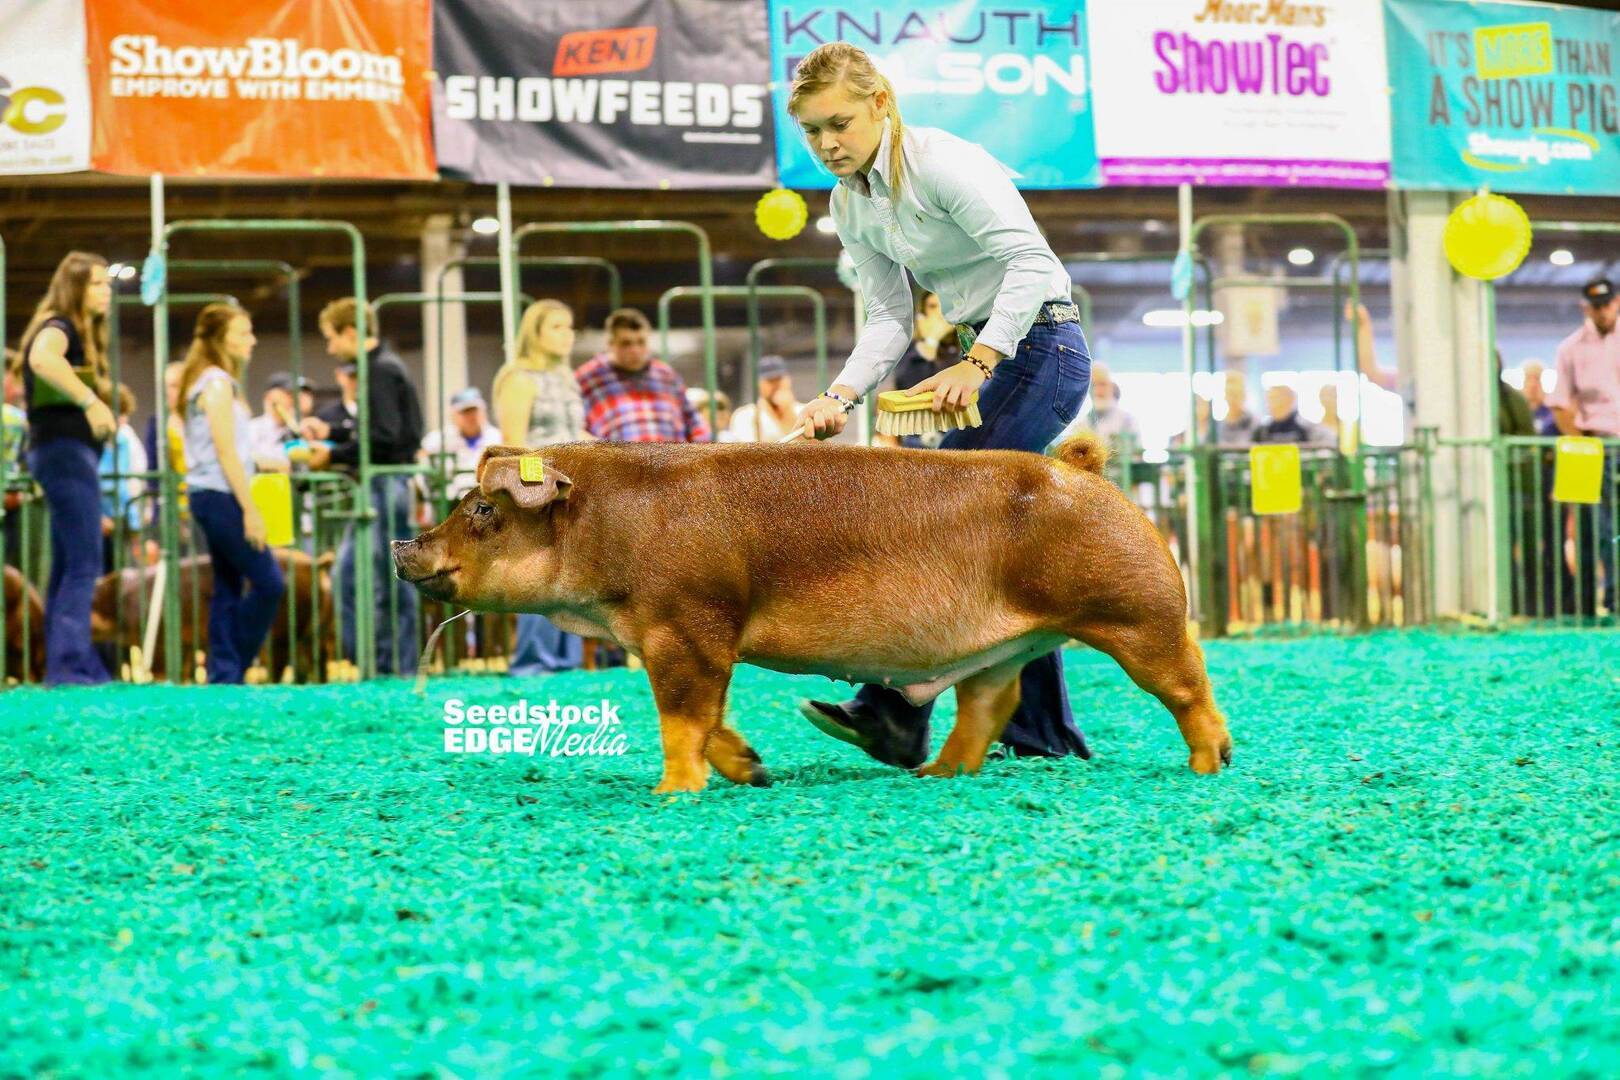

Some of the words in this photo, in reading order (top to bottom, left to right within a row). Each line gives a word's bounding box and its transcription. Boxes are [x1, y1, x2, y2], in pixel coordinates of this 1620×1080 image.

[784, 10, 1080, 46] KNAUTH
[111, 35, 402, 83] ShowBloom
[562, 36, 648, 65] KENT
[1153, 31, 1330, 96] ShowTec
[1554, 39, 1611, 76] THAN
[111, 78, 229, 98] EMPROVE
[237, 79, 300, 99] WITH
[446, 76, 763, 127] SHOWFEEDS
[1429, 74, 1449, 125] A
[1463, 75, 1554, 129] SHOW
[1567, 81, 1619, 134] PIG
